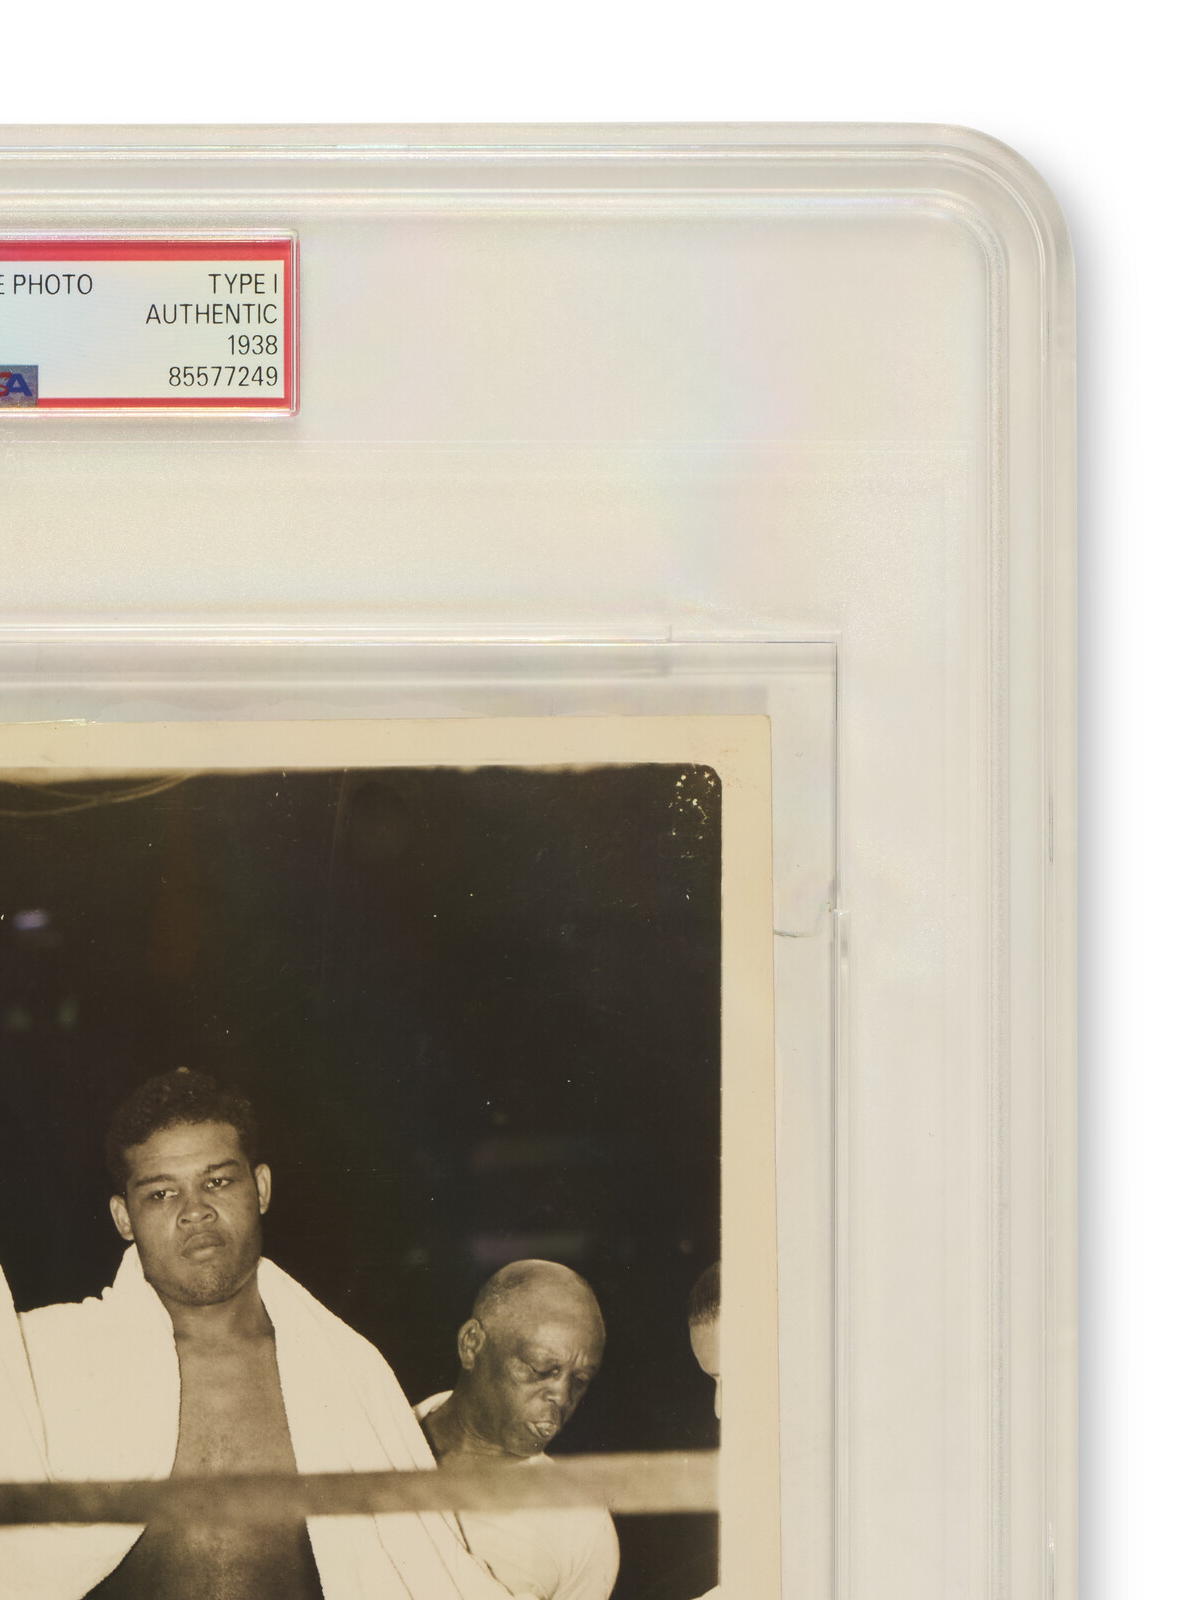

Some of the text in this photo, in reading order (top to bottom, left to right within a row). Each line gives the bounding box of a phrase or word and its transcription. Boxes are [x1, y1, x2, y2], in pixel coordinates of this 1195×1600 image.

[13, 273, 93, 296] PHOTO
[208, 273, 266, 295] TYPE
[145, 303, 278, 325] AUTHENTIC
[228, 334, 278, 356] 1938
[168, 365, 278, 387] 85577249
